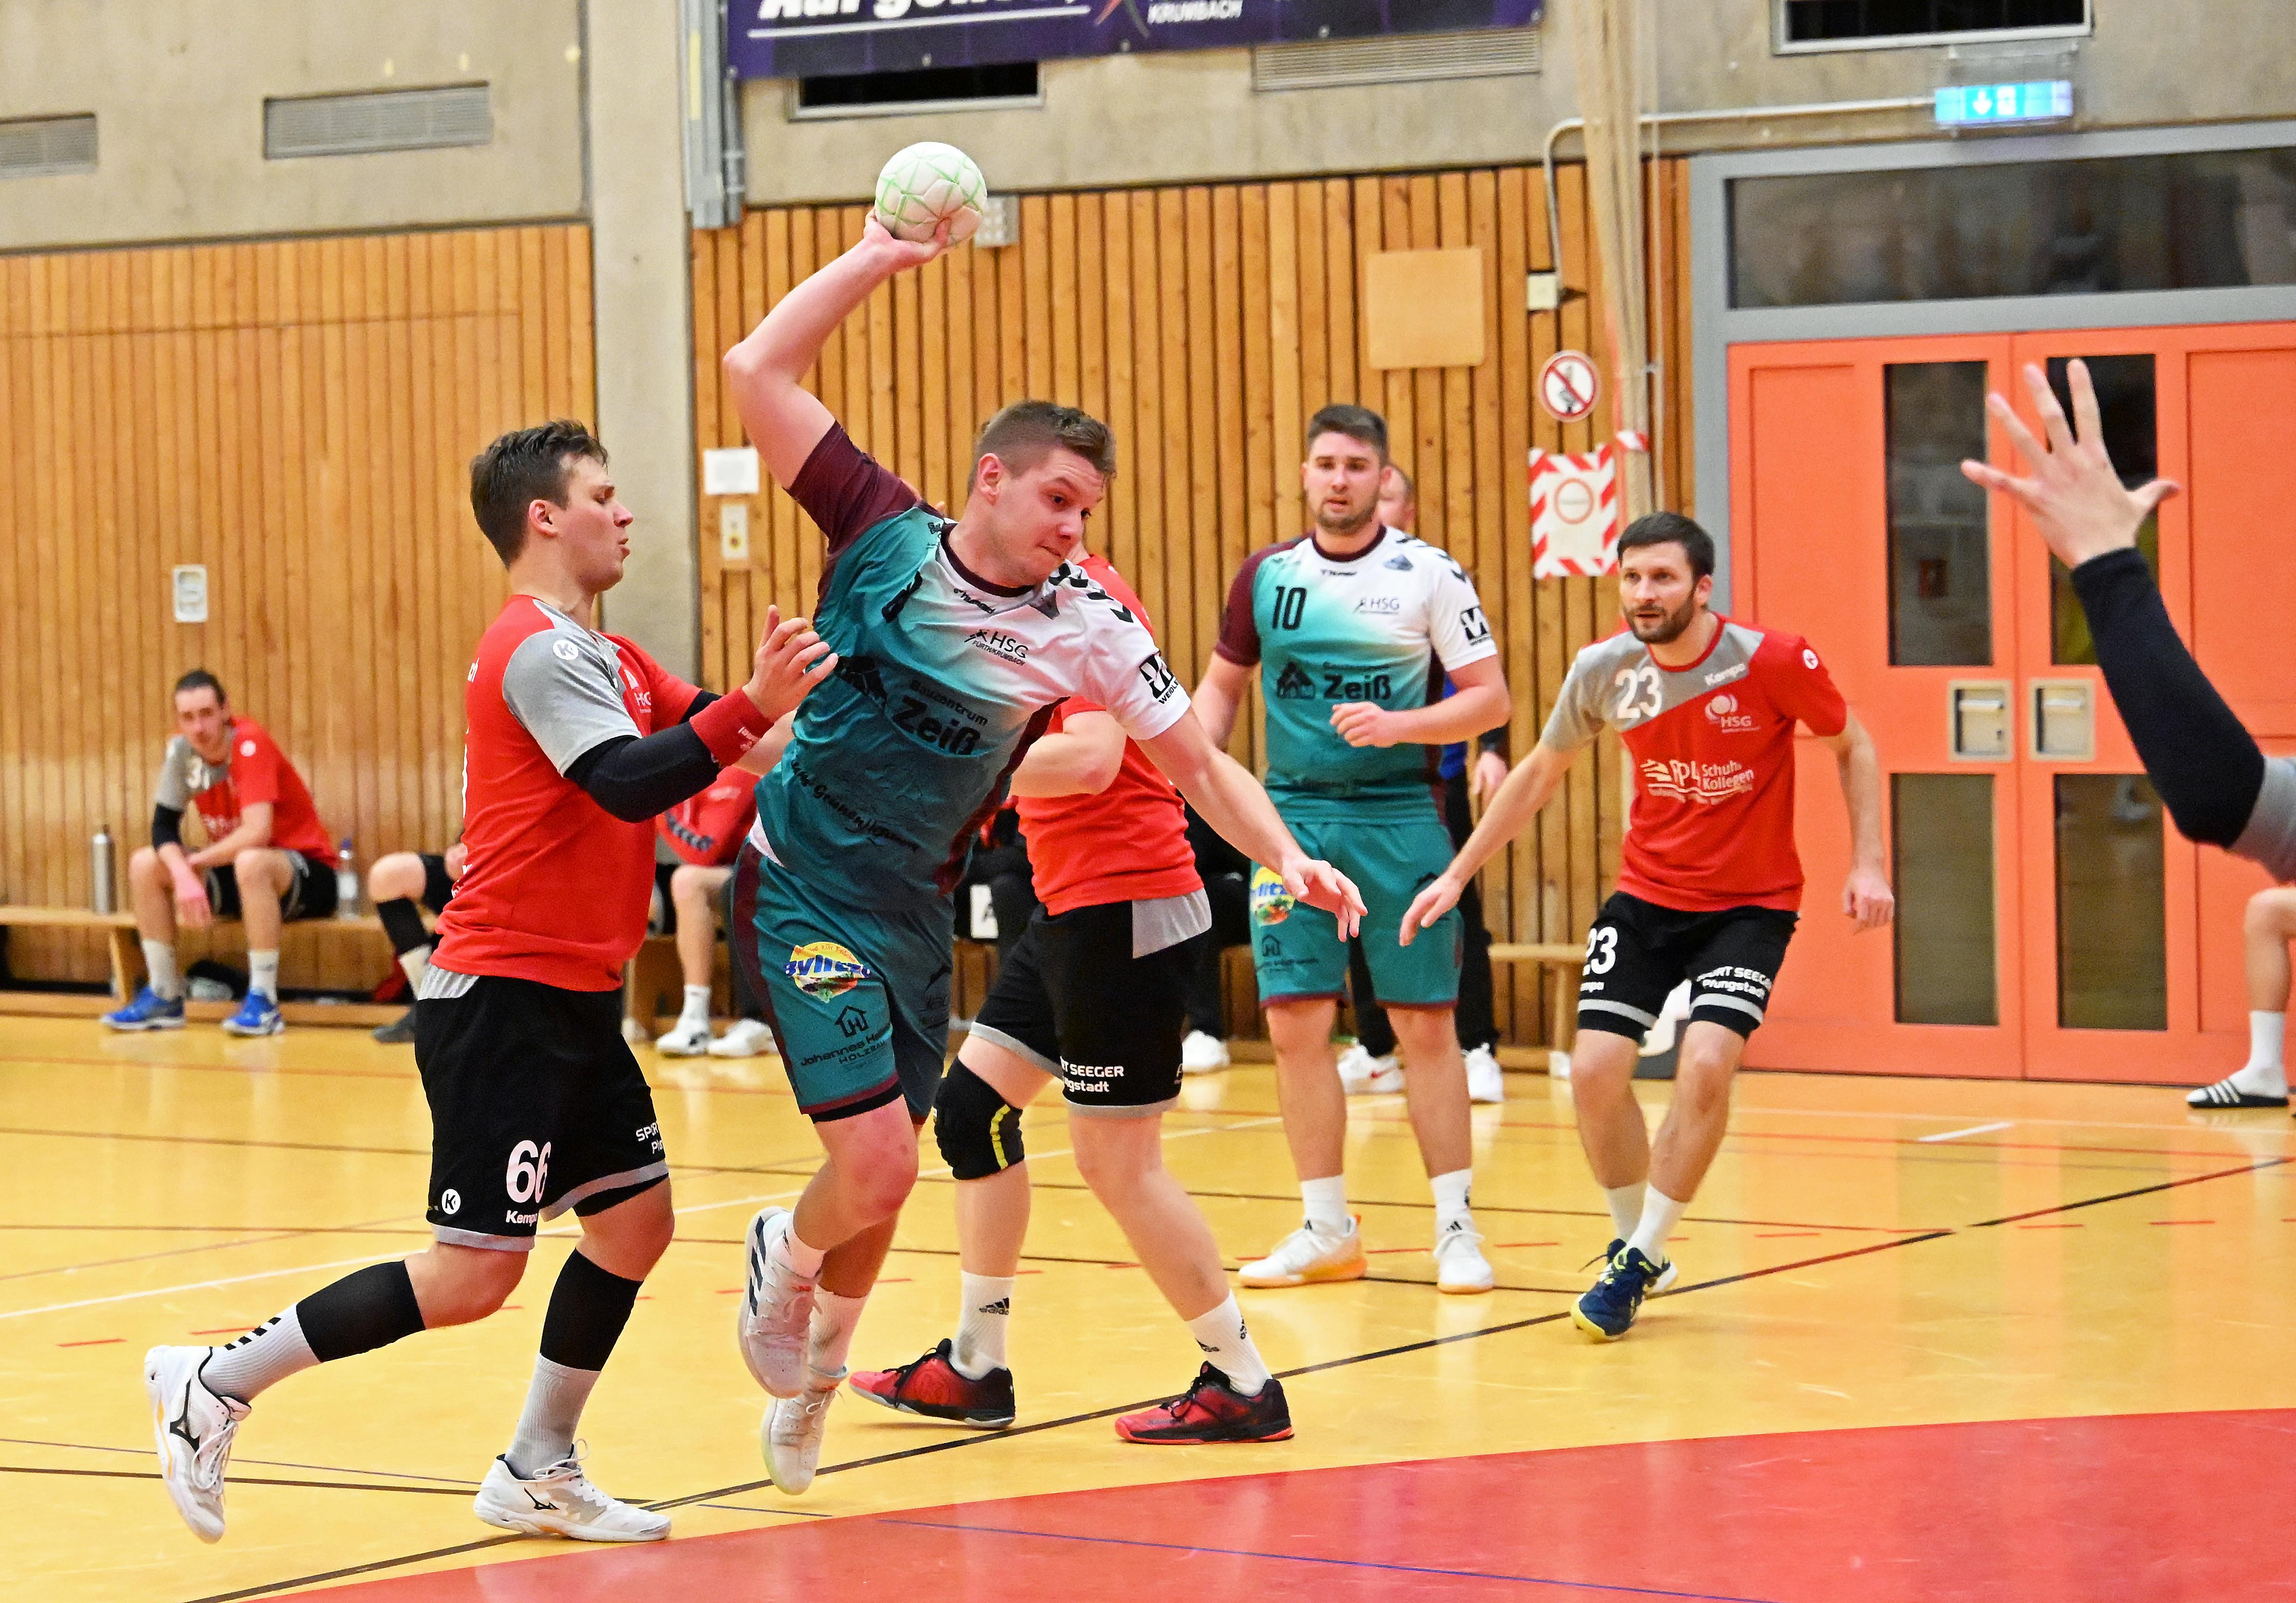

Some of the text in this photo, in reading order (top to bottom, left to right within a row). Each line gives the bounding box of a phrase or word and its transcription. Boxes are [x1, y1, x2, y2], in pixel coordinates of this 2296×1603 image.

[1272, 586, 1306, 630] 10
[1370, 597, 1399, 610] HSG
[990, 631, 1029, 659] HSG
[1324, 674, 1391, 700] Zeiß
[1615, 666, 1662, 719] 23
[892, 697, 981, 755] Zeiß
[1721, 716, 1752, 728] HSG
[1070, 1063, 1125, 1077] SEEGER
[506, 1140, 551, 1204] 66
